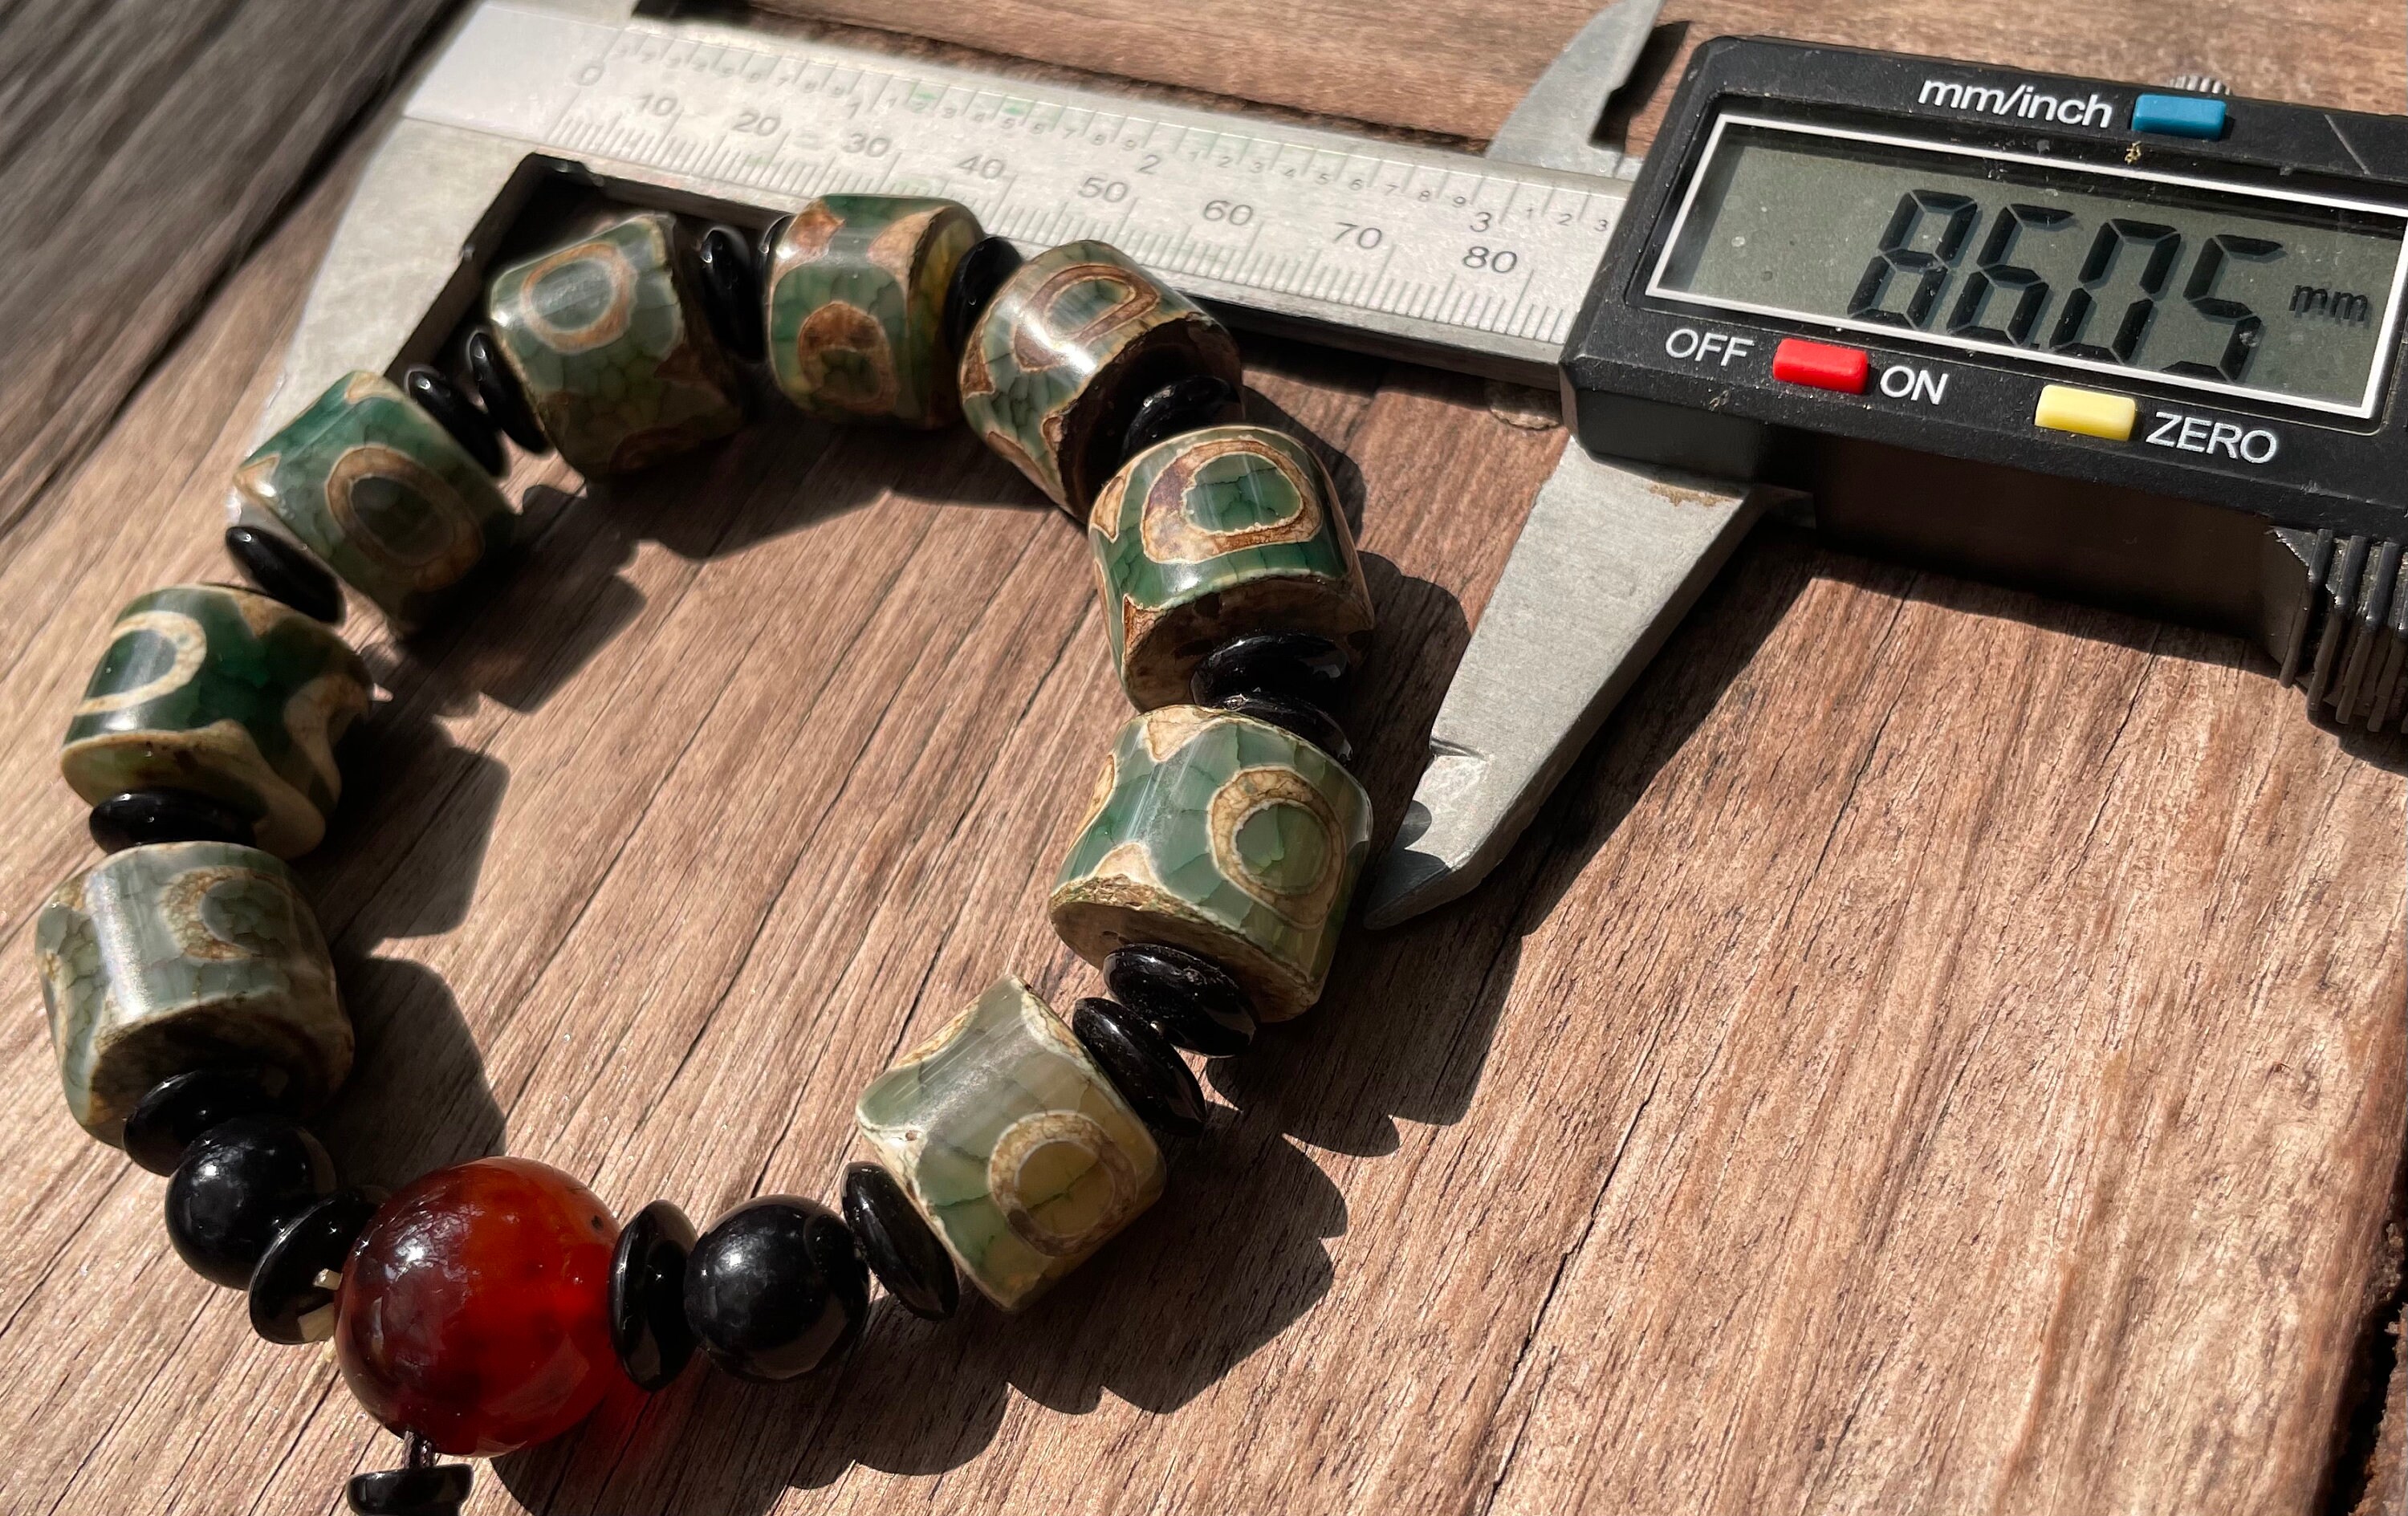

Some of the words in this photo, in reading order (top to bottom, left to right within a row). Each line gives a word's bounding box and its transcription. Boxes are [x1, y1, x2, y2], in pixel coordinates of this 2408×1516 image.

[1918, 79, 2113, 128] mm/inch
[573, 61, 604, 87] 0
[639, 91, 678, 116] 10
[731, 112, 781, 137] 20
[843, 132, 892, 158] 30
[955, 153, 1006, 180] 40
[1078, 176, 1129, 203] 50
[1202, 200, 1255, 227] 60
[1332, 221, 1383, 250] 70
[1462, 245, 1519, 274] 80
[1136, 153, 1161, 176] 2
[1469, 211, 1493, 233] 3
[2289, 284, 2369, 323] mm
[1665, 328, 1755, 367] OFF
[1879, 365, 1949, 405] ON
[2146, 411, 2278, 464] ZERO
